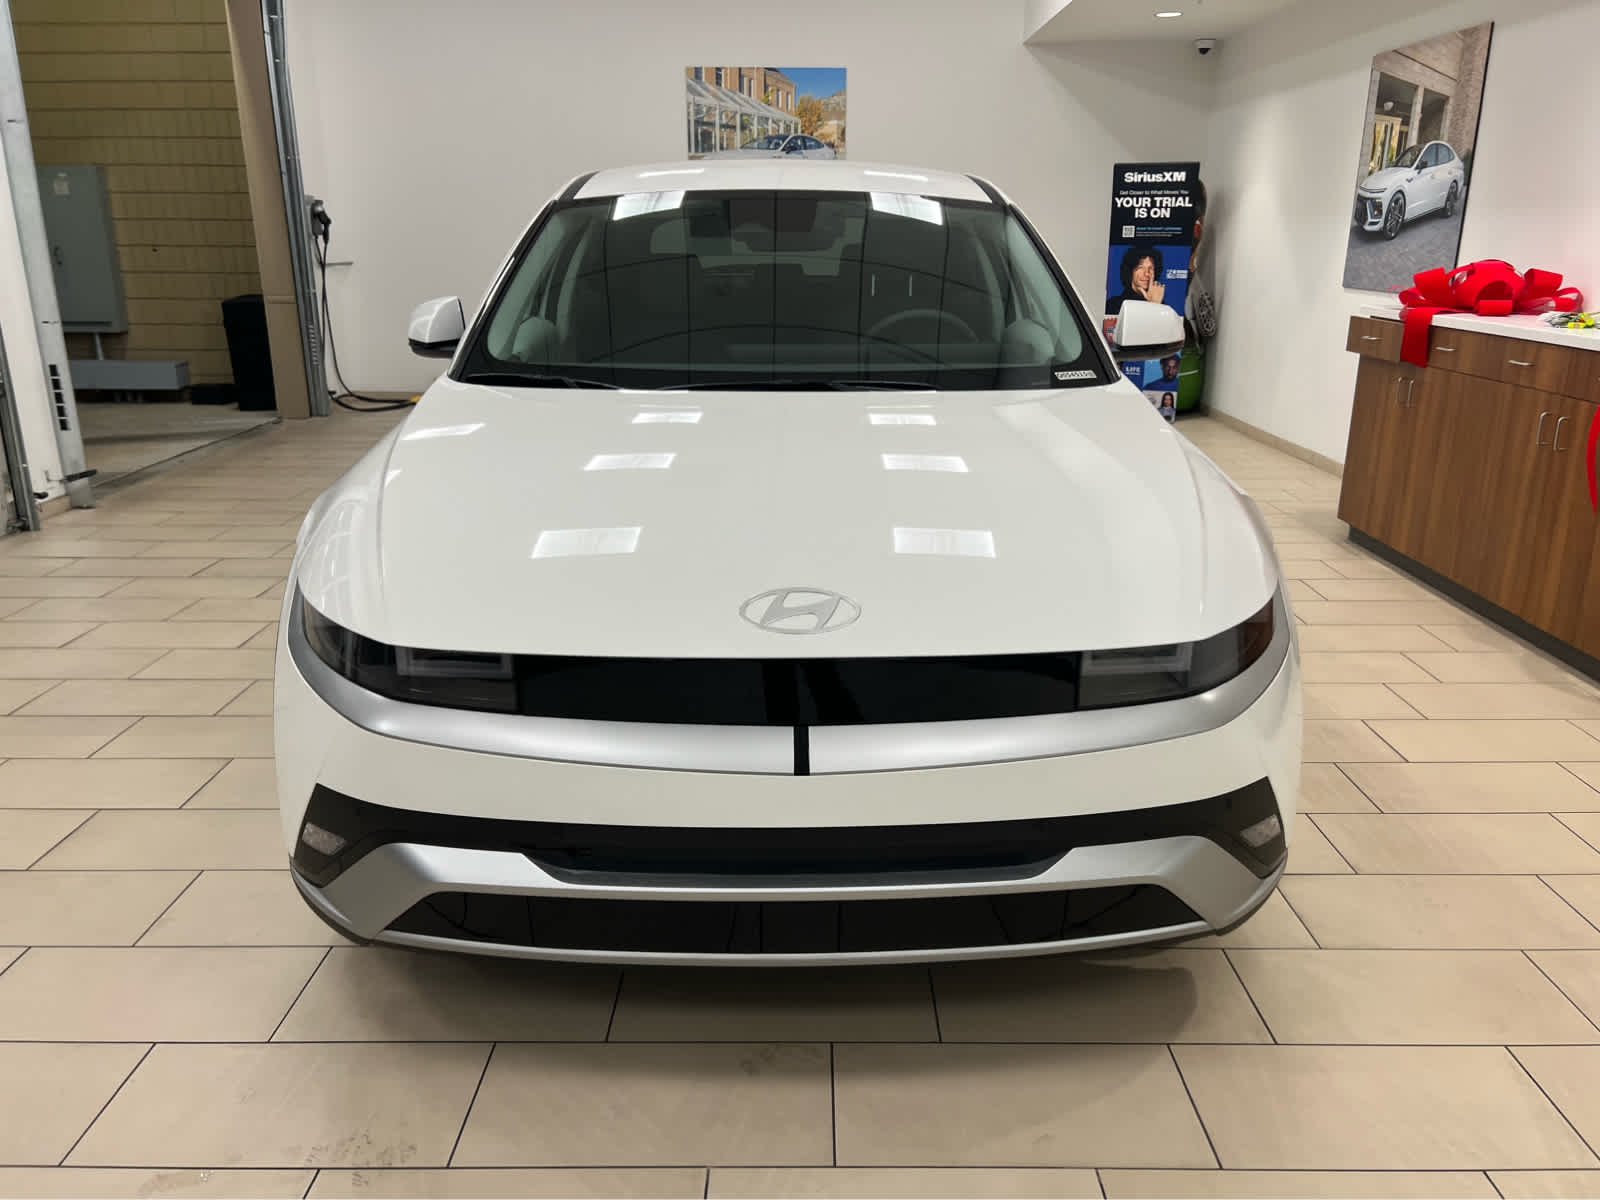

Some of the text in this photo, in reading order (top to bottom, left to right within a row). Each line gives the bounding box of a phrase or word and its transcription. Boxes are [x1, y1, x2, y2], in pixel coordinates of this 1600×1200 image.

[1124, 171, 1186, 183] SiriusXM
[1115, 196, 1193, 208] YOUR TRIAL
[1134, 207, 1171, 218] IS ON
